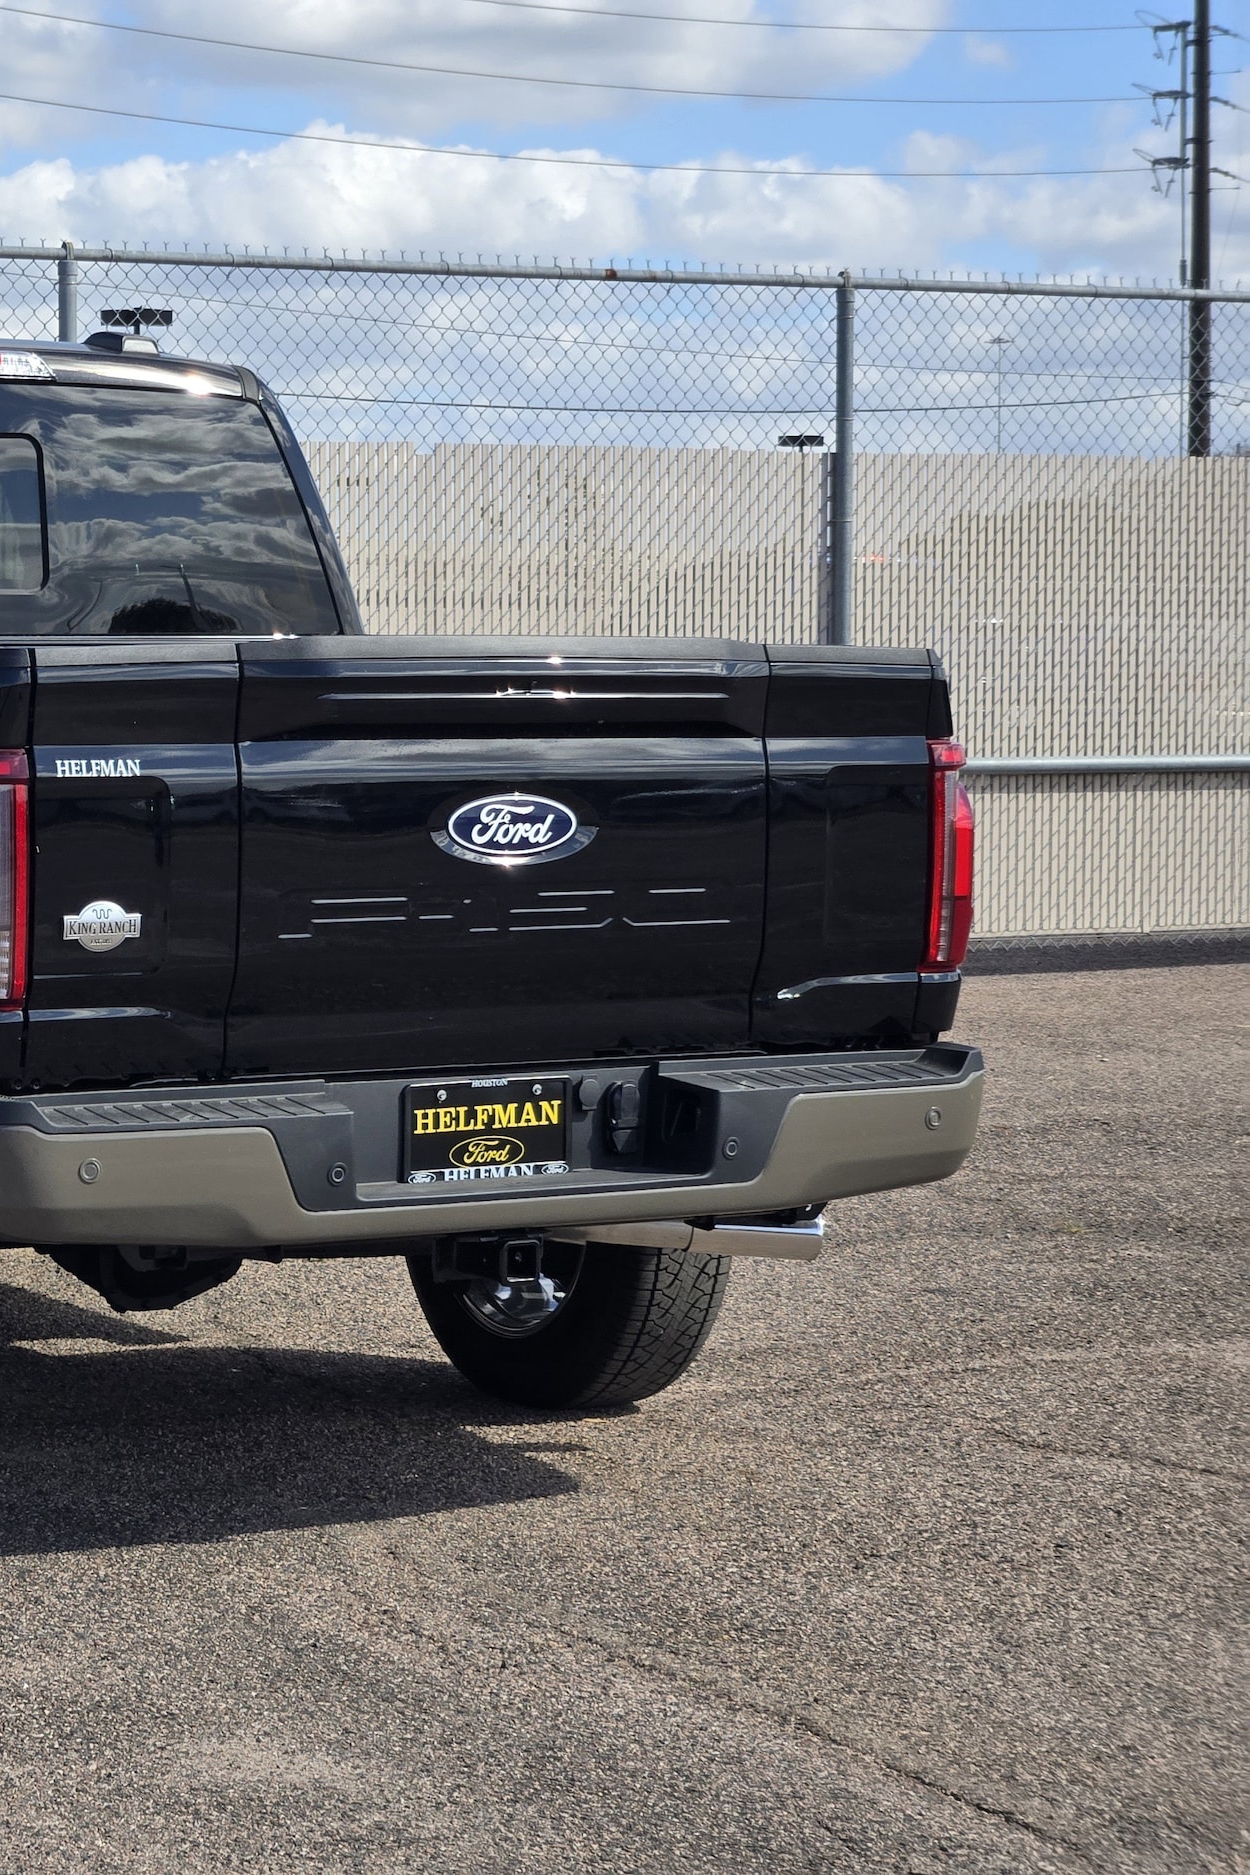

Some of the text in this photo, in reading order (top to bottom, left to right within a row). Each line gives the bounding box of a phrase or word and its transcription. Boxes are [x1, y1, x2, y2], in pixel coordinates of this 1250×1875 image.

[55, 759, 141, 778] HELFMAN
[471, 804, 555, 845] Ford
[69, 919, 137, 935] KING RANCH
[471, 1078, 510, 1088] HOUSTON
[413, 1100, 562, 1134] HELFMAN
[463, 1140, 511, 1164] Ford
